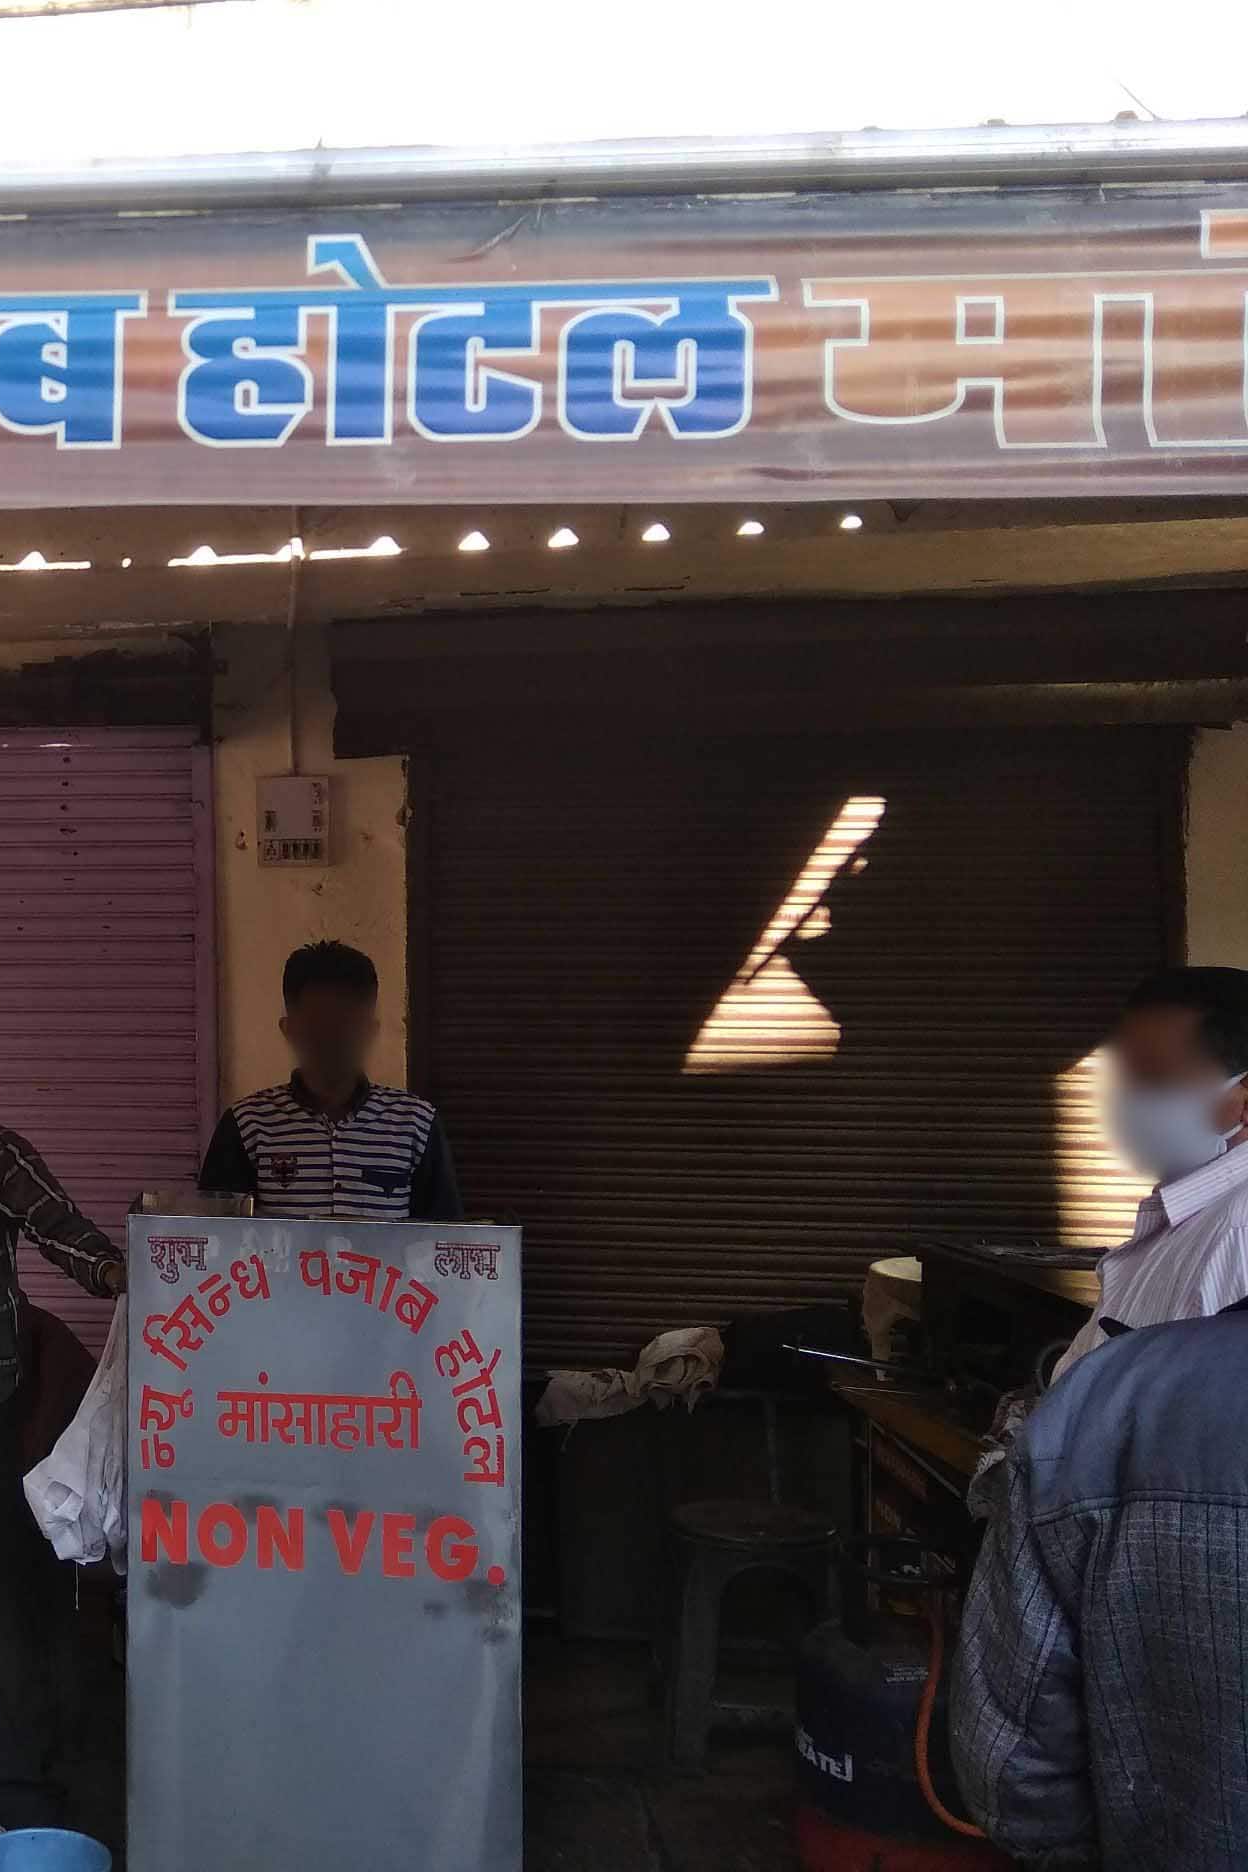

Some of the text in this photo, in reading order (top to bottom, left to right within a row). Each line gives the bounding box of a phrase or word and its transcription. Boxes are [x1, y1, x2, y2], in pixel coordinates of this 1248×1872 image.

[168, 233, 780, 450] होटल
[146, 1236, 501, 1284] शुभ लाभ
[143, 1253, 272, 1372] सिन्ध
[139, 1384, 194, 1470] न्यू
[216, 1370, 423, 1452] मांसाहारी
[433, 1329, 506, 1487] होटल
[140, 1497, 507, 1586] NON VEG.
